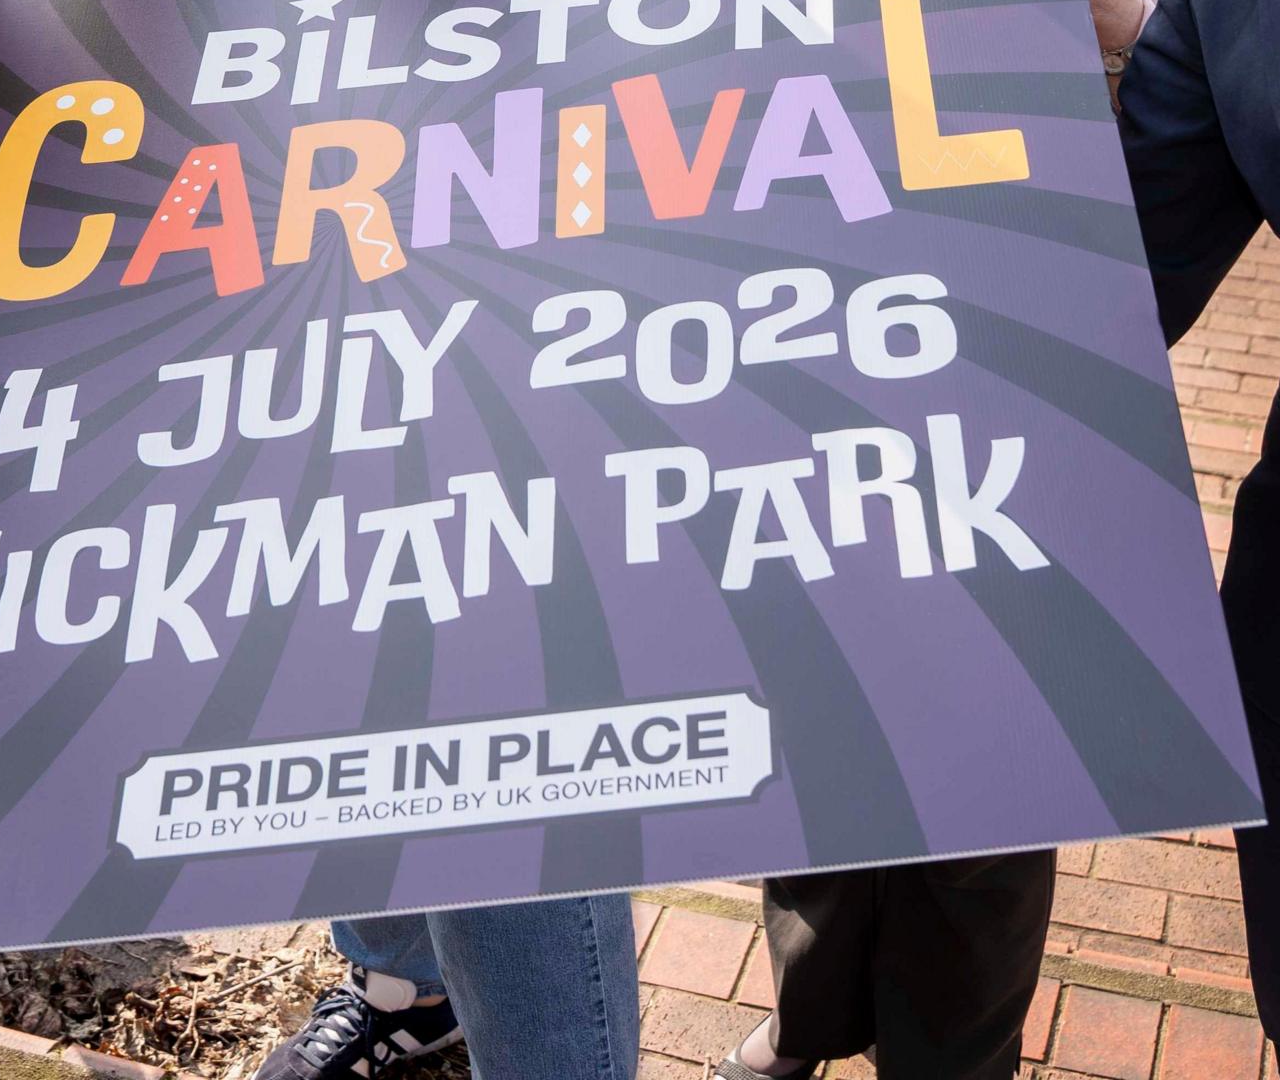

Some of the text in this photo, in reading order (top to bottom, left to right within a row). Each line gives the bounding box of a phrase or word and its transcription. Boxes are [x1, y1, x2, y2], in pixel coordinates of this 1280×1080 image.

[137, 299, 480, 467] JULY
[530, 267, 958, 405] 2026
[604, 413, 1051, 592] PARK
[154, 821, 202, 842] LED
[211, 816, 245, 836] BY
[254, 810, 308, 832] YOU
[338, 796, 443, 824] BACKED
[452, 791, 487, 812] BY
[496, 785, 532, 808] UK
[541, 765, 730, 802] GOVERNMENT
[159, 710, 729, 816] PRIDE IN PLACE
